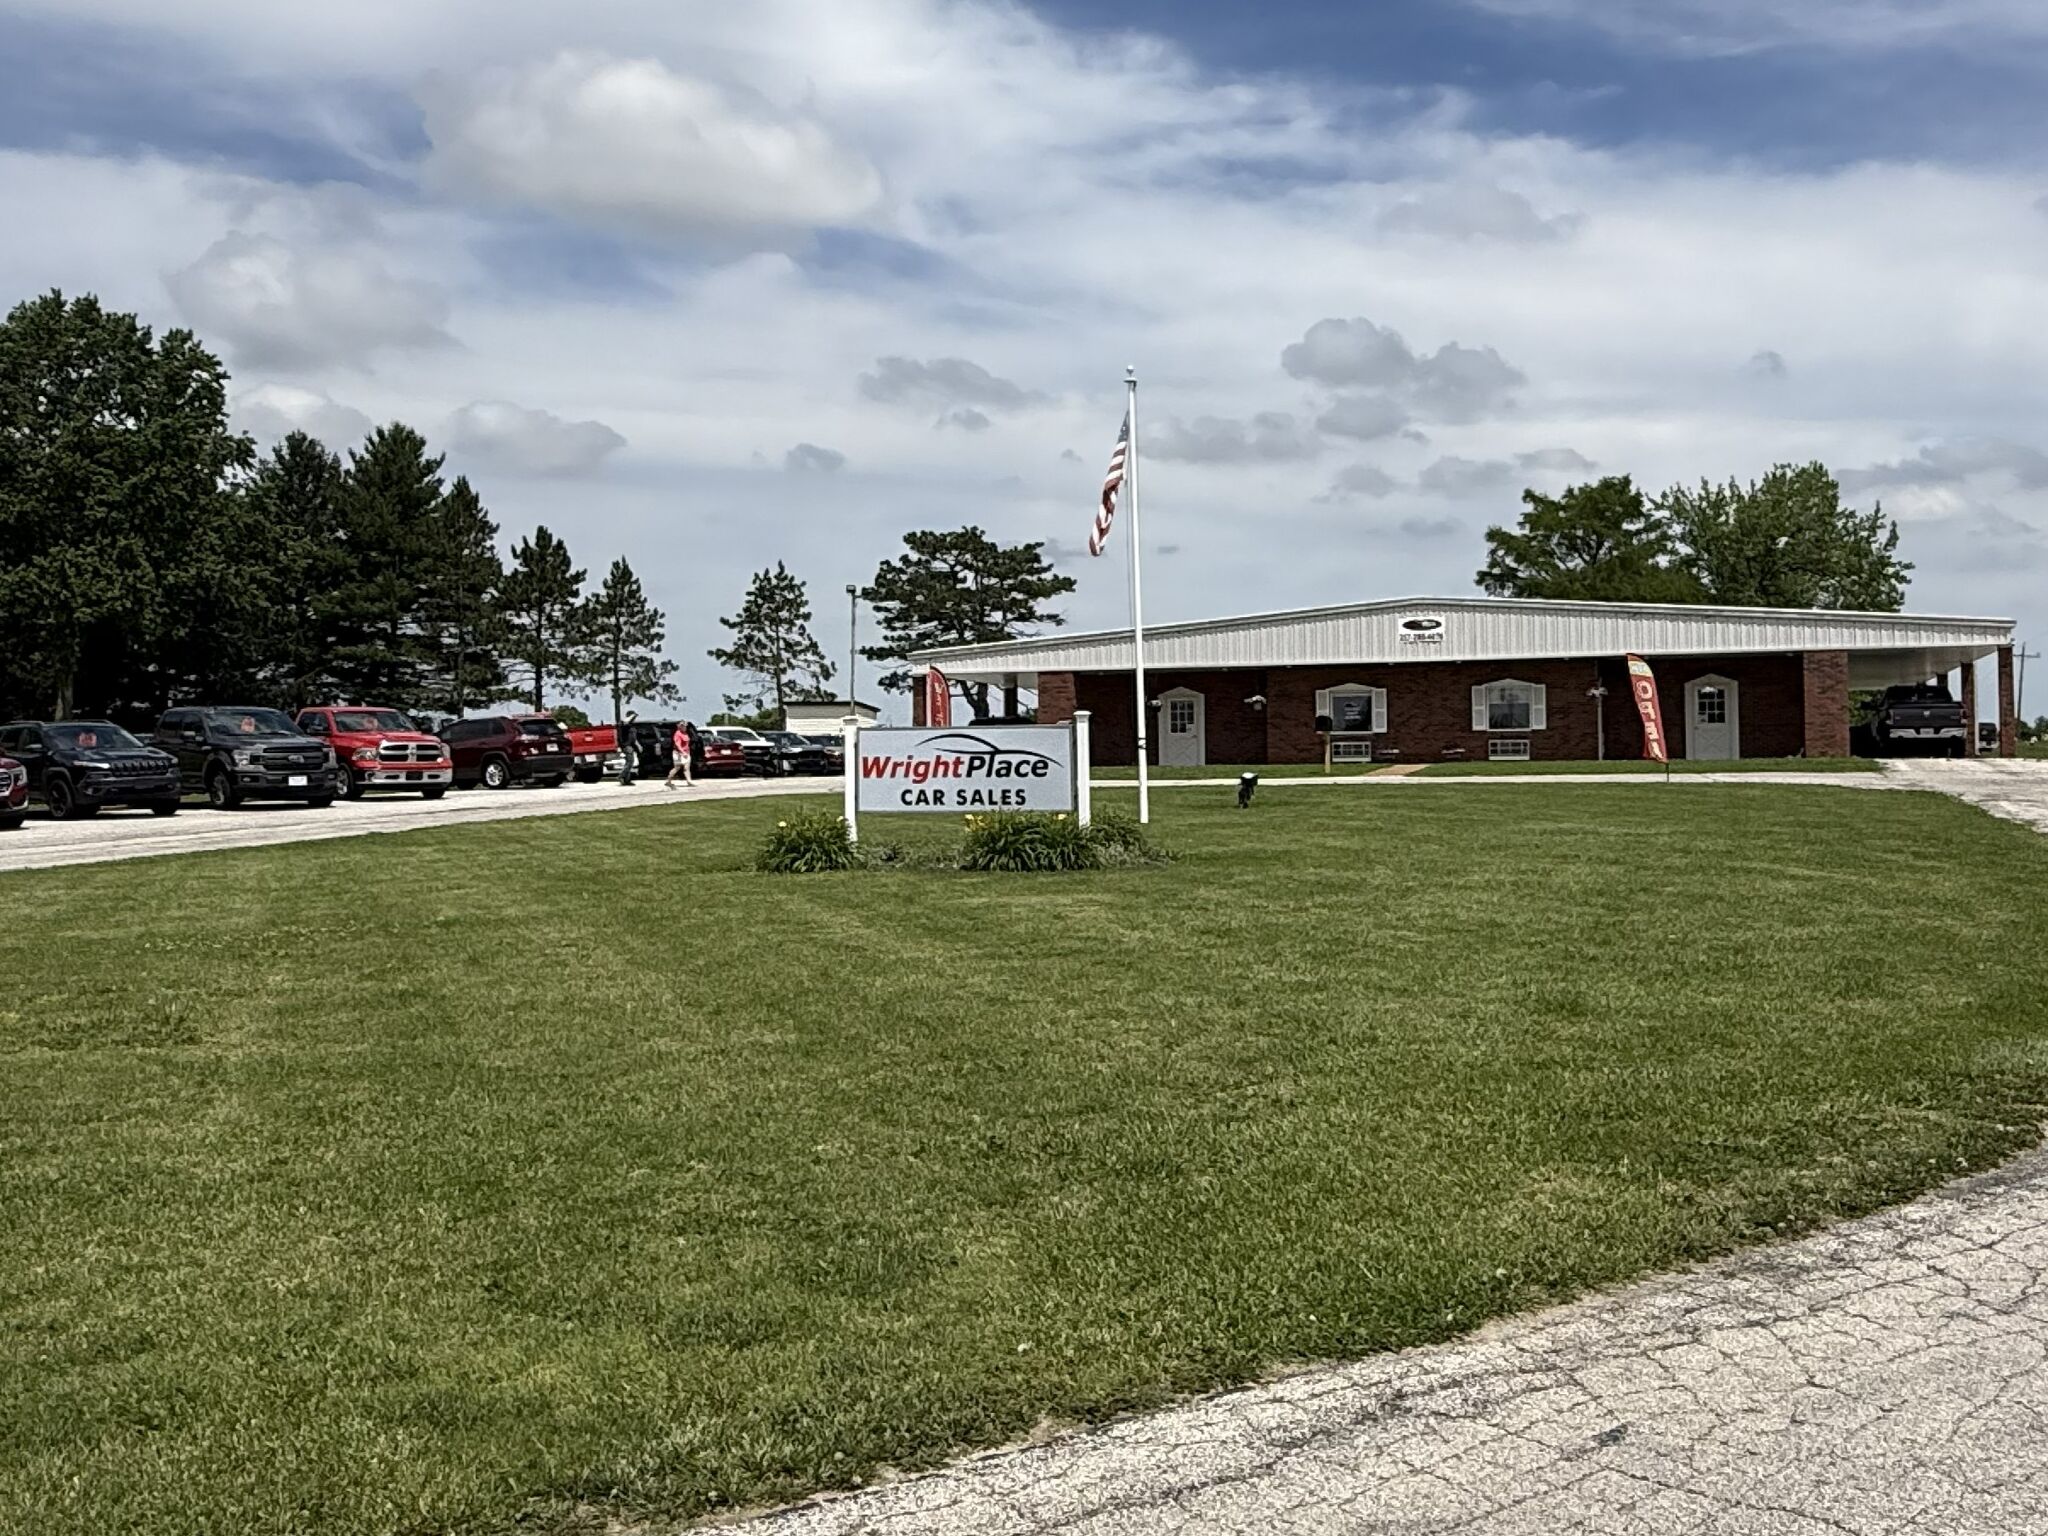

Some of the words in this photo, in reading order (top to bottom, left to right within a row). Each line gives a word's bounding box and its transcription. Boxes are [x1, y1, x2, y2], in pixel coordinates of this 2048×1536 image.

[861, 754, 1049, 784] WrightPlace
[900, 788, 946, 806] CAR
[956, 788, 1027, 806] SALES
